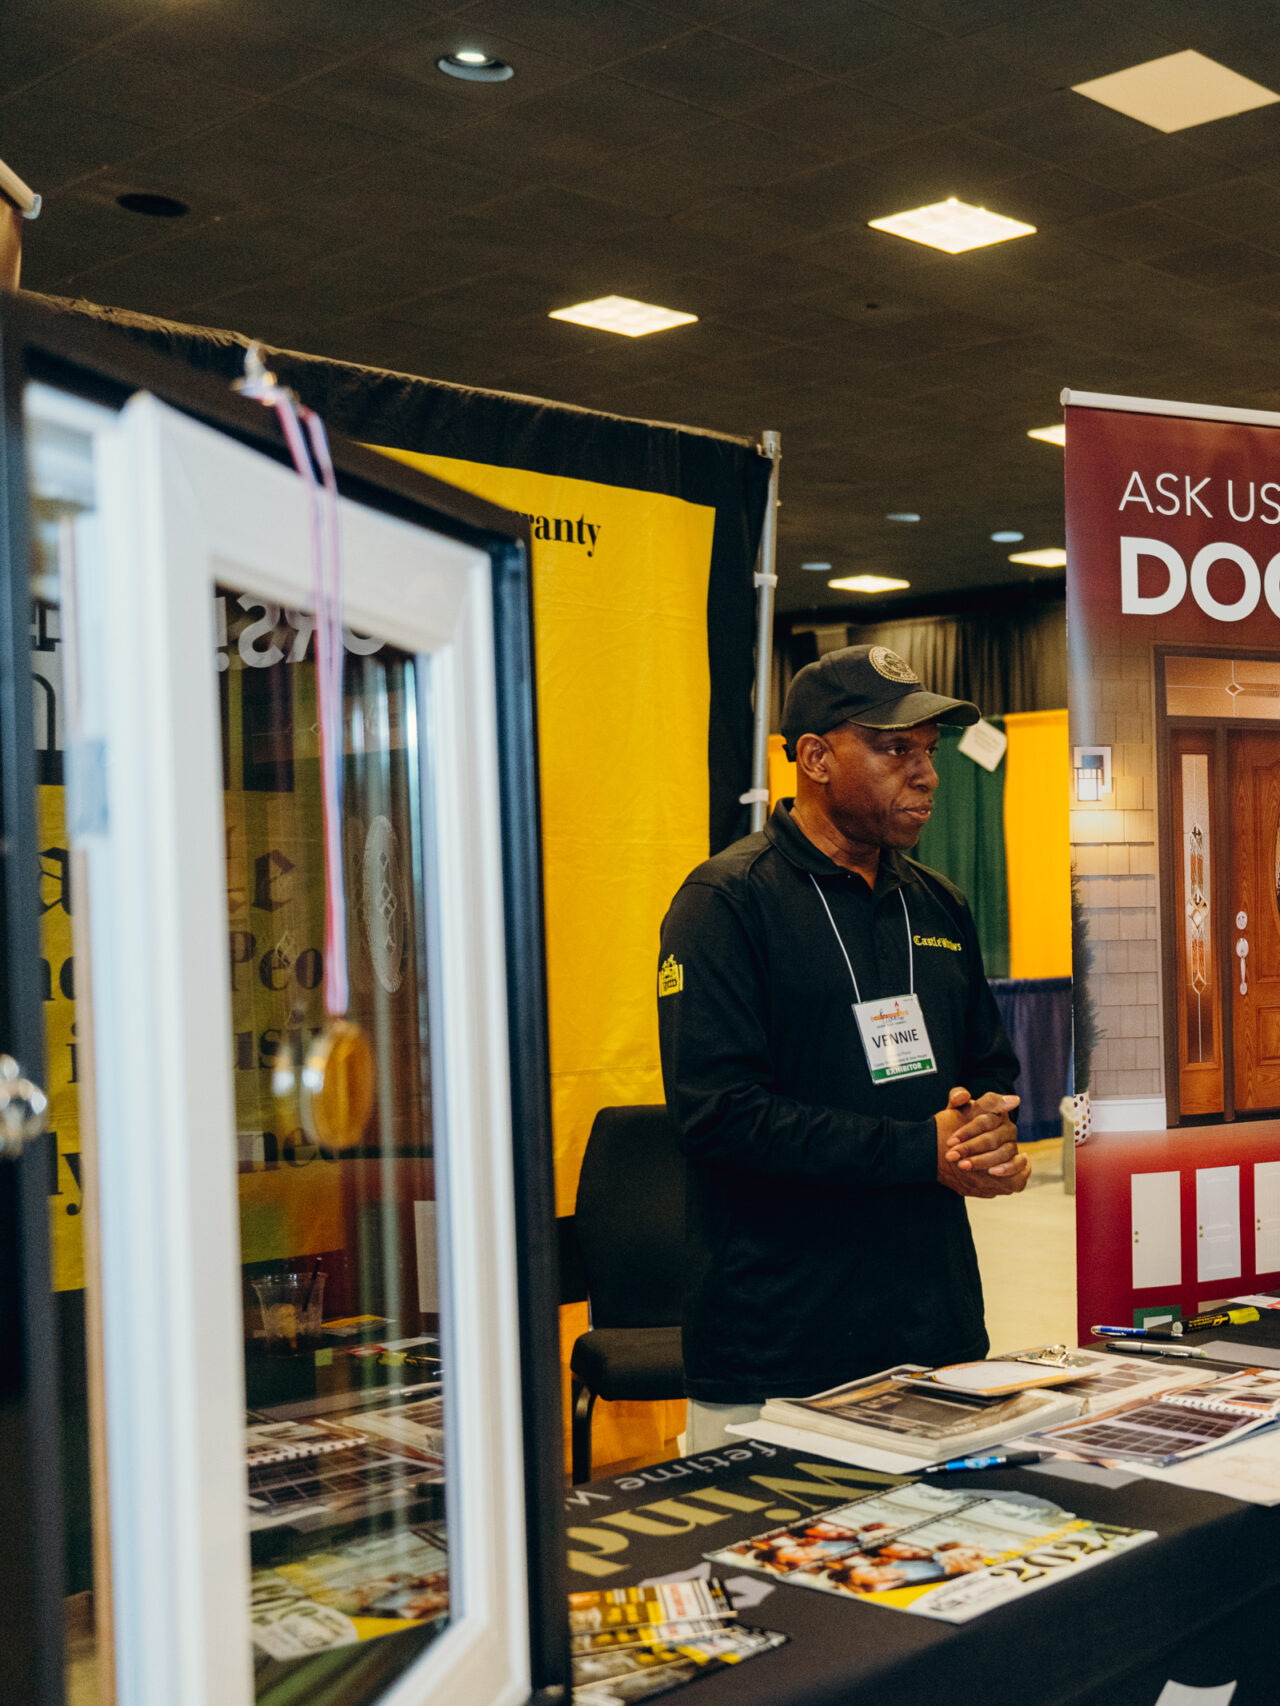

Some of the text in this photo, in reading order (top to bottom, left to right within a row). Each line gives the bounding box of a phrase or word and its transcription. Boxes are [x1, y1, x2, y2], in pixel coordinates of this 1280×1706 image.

[1118, 471, 1213, 518] ASK
[528, 512, 602, 557] anty
[872, 1029, 919, 1048] VENNIE
